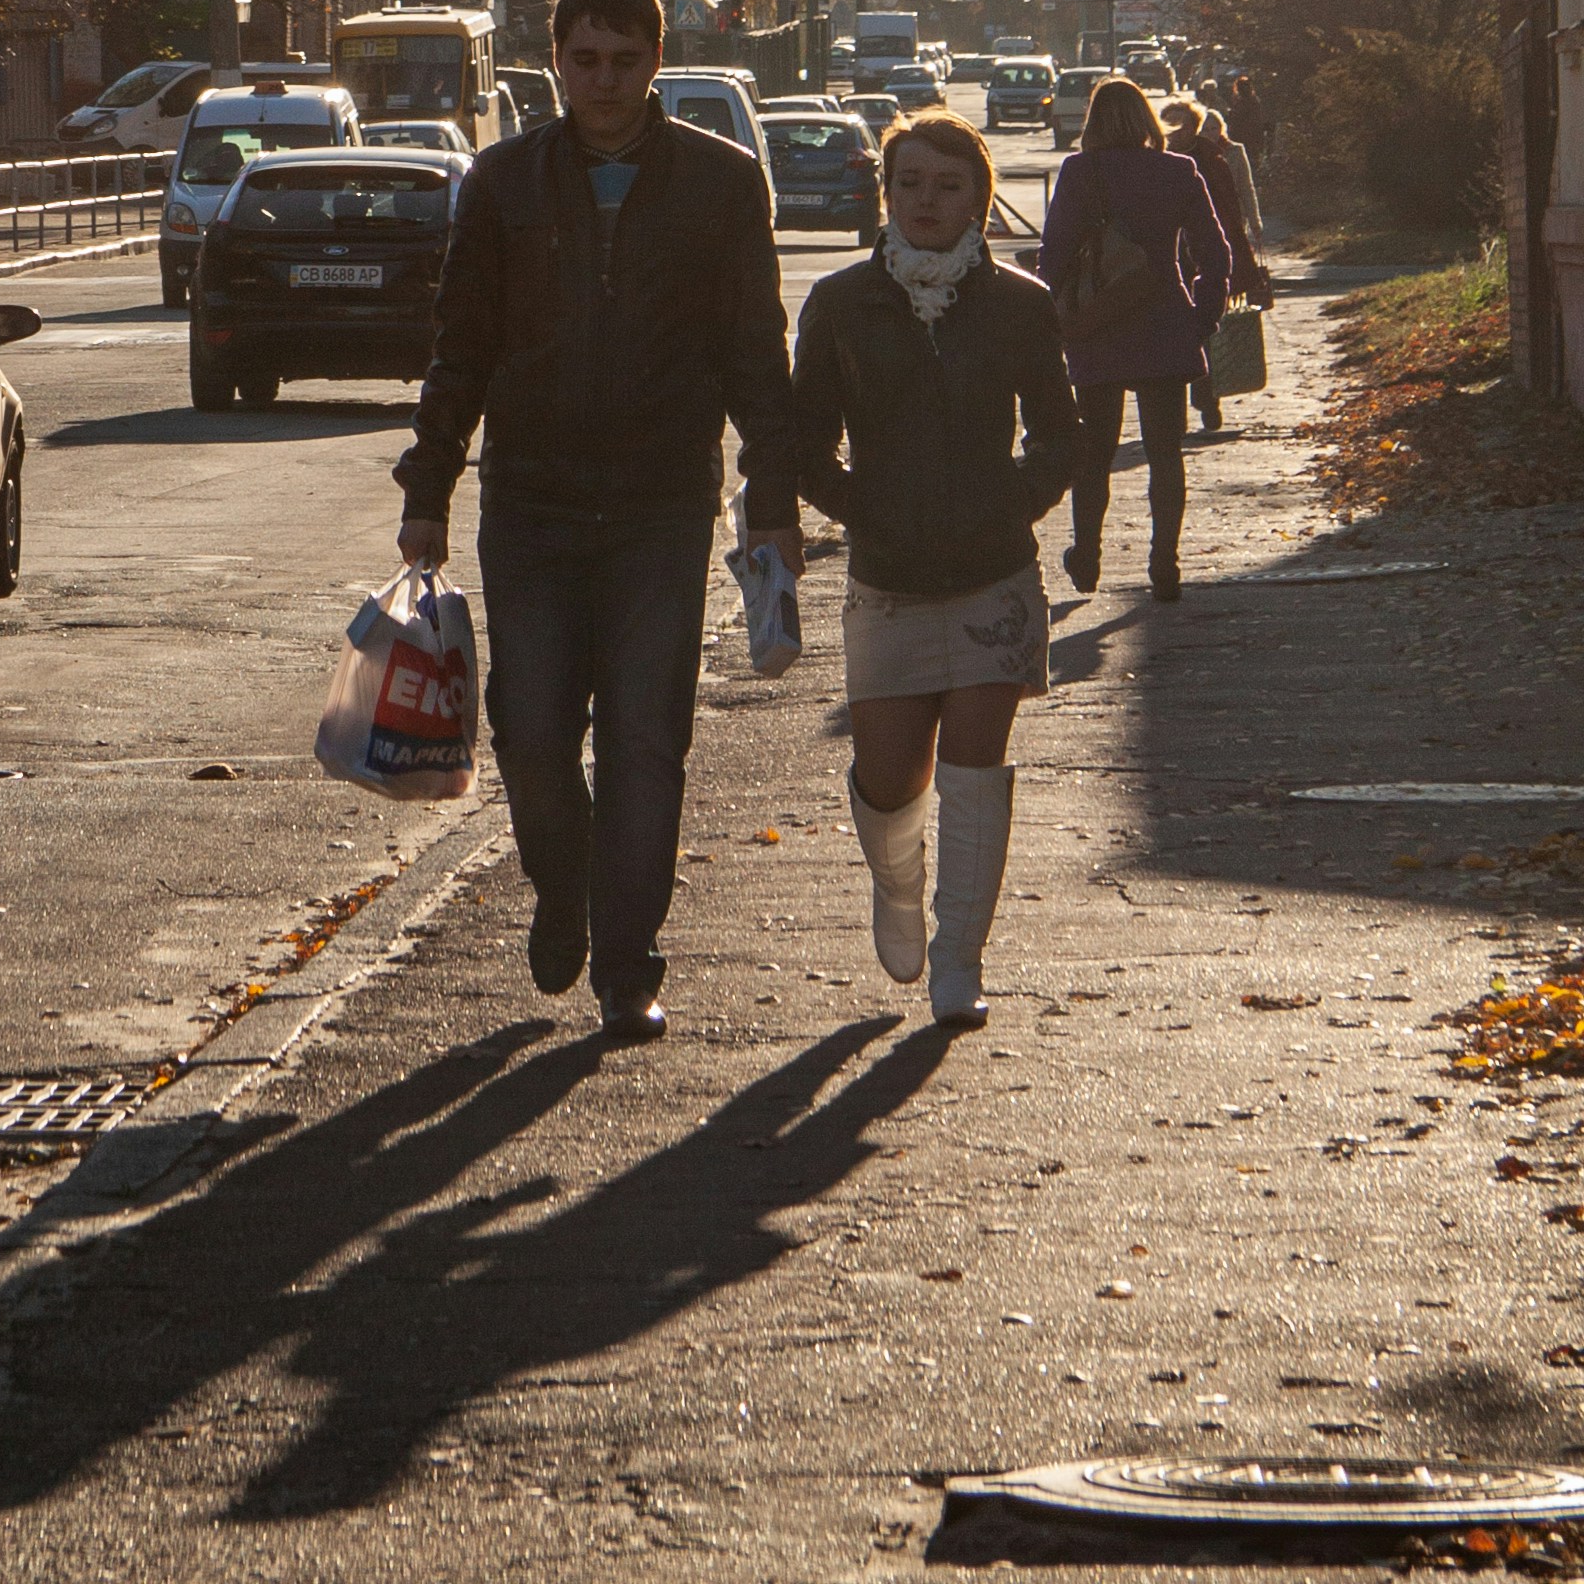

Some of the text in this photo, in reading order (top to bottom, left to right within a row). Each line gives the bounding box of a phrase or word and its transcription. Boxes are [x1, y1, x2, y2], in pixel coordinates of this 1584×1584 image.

[299, 267, 379, 282] CB 8688 AP
